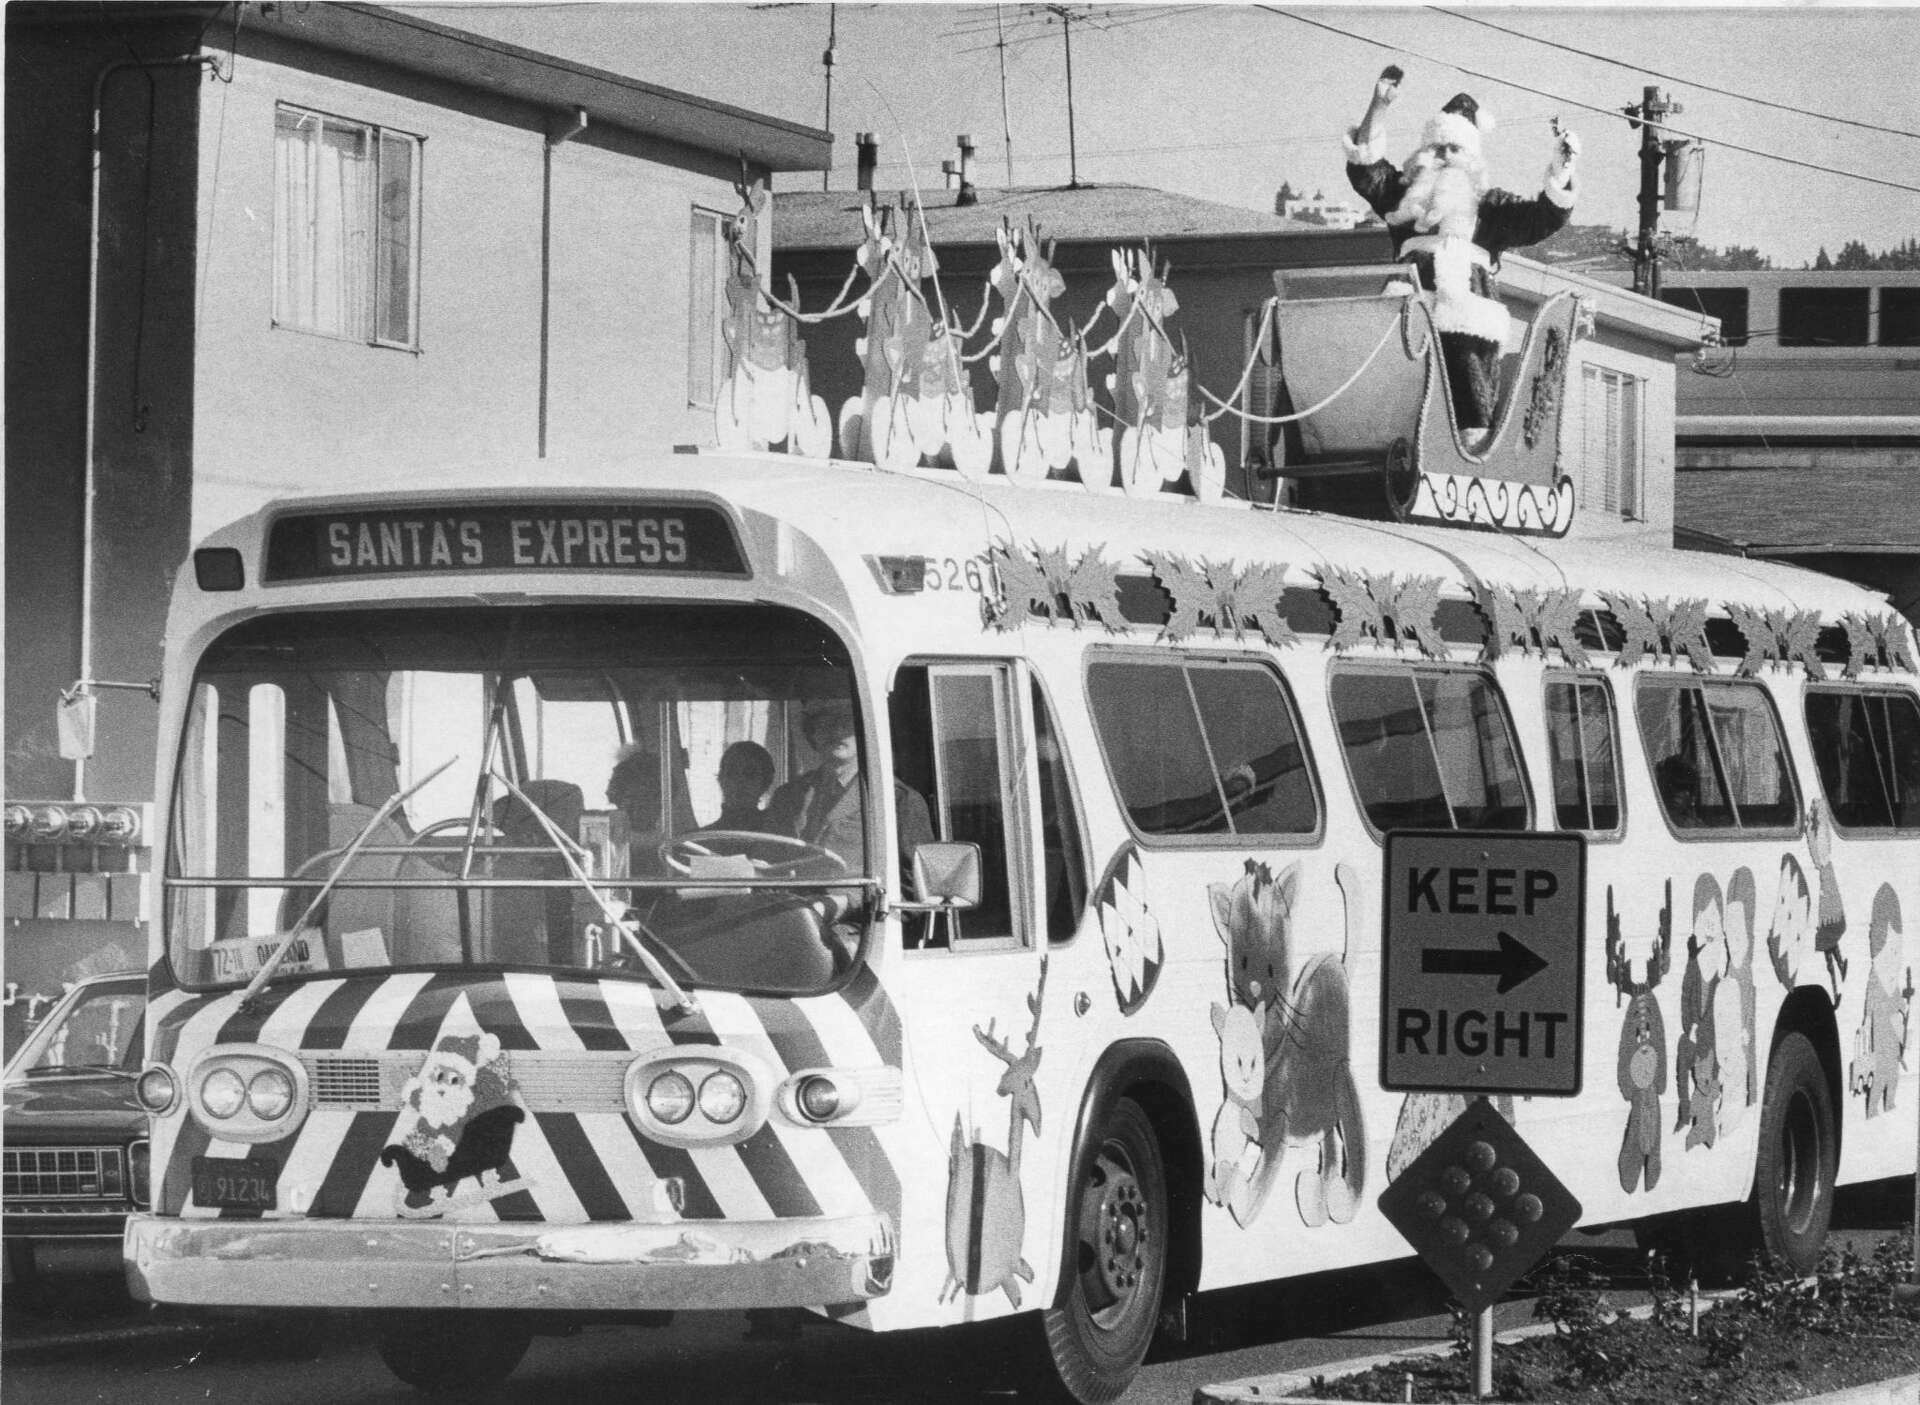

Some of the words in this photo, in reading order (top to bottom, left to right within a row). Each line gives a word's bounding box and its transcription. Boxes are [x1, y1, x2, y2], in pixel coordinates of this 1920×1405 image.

[328, 517, 484, 568] SANTA'S
[510, 517, 688, 565] EXPRESS
[923, 556, 982, 593] 526
[1407, 866, 1559, 916] KEEP
[1395, 1007, 1569, 1059] RIGHT
[216, 1176, 270, 1203] 91234
